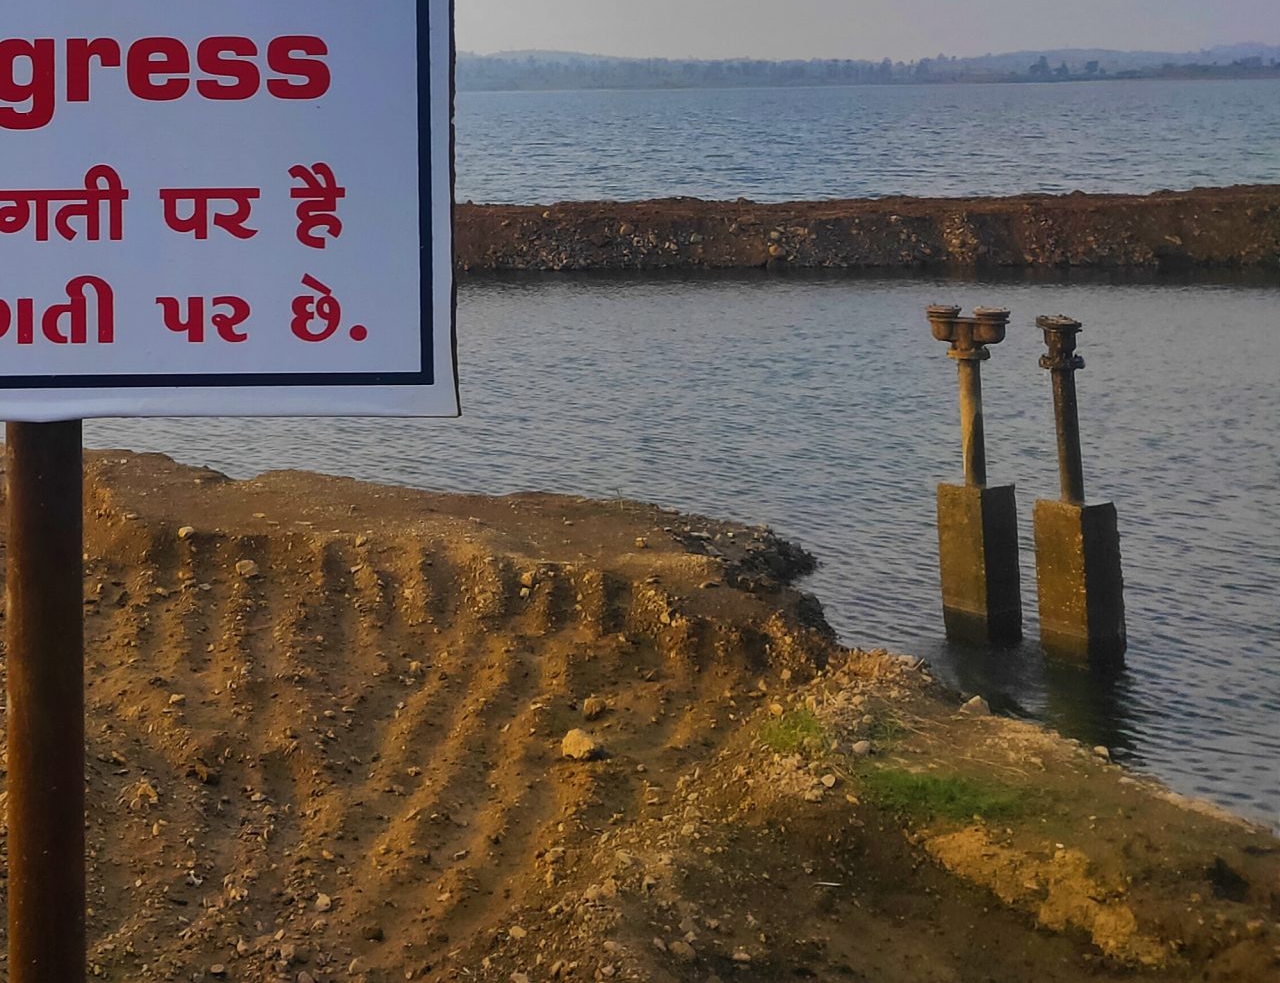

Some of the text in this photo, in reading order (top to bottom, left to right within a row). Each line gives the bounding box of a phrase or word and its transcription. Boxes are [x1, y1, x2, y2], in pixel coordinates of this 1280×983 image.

[160, 187, 261, 240] पर
[288, 162, 346, 249] है
[156, 295, 251, 343] પર
[291, 273, 368, 343] છે.
